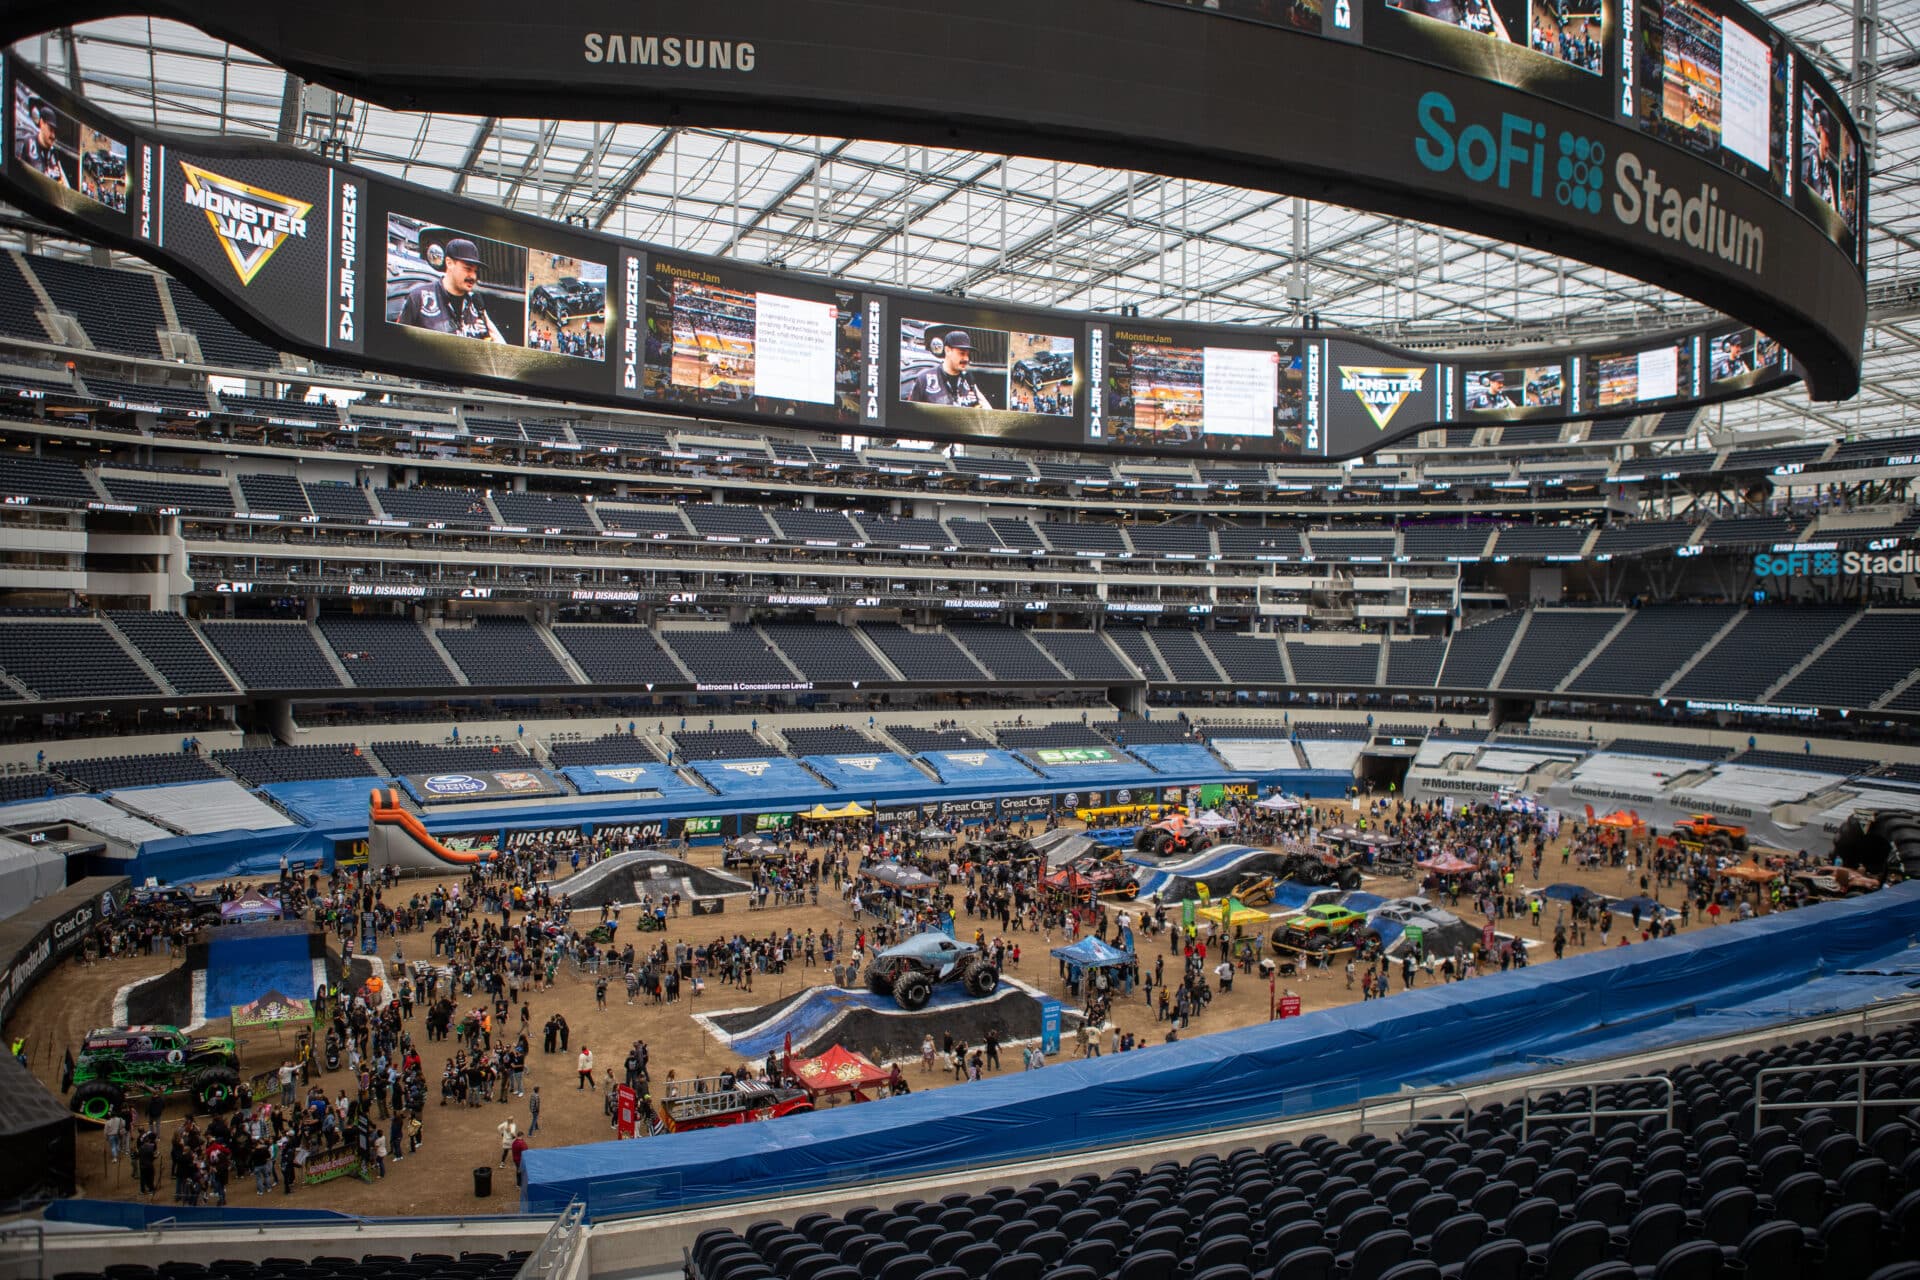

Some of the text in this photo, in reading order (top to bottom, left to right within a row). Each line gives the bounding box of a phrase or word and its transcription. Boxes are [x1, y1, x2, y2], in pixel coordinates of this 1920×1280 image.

[584, 33, 755, 72] SAMSUNG
[1415, 91, 1765, 275] SoFi Stadium
[185, 183, 306, 239] MONSTER
[219, 218, 274, 249] JAM
[339, 183, 357, 341] #MONSTERJAM
[655, 263, 721, 283] #MonsterJam
[624, 257, 639, 389] #MONSTERJAM
[1115, 331, 1172, 344] #MonsterJam
[867, 301, 881, 419] #MONSTERJAM
[1090, 329, 1103, 438] #MONSTERJAM
[1341, 378, 1423, 392] MONSTER
[1307, 345, 1319, 449] #MONSTERJAM
[1364, 391, 1400, 404] JAM
[1754, 553, 1809, 576] SoFi
[348, 585, 426, 596] RYAN DISHAROON
[572, 590, 594, 599] RYAN
[768, 595, 788, 604] RYAN
[944, 600, 962, 608] RYAN
[696, 683, 732, 691] Restrooms
[740, 682, 780, 690] Concessions
[791, 682, 808, 690] Level
[1686, 700, 1726, 711] Restrooms
[1792, 706, 1811, 715] Level
[1392, 738, 1406, 746] Exit
[1422, 778, 1500, 794] #MonsterJam
[971, 800, 994, 814] Clips
[1002, 796, 1050, 810] Great Clips
[1670, 795, 1753, 818] #MonsterJam
[642, 824, 663, 838] OIL
[686, 818, 721, 832] BKT
[31, 832, 46, 842] Exit
[507, 830, 551, 847] LUCAS
[54, 918, 76, 938] Great
